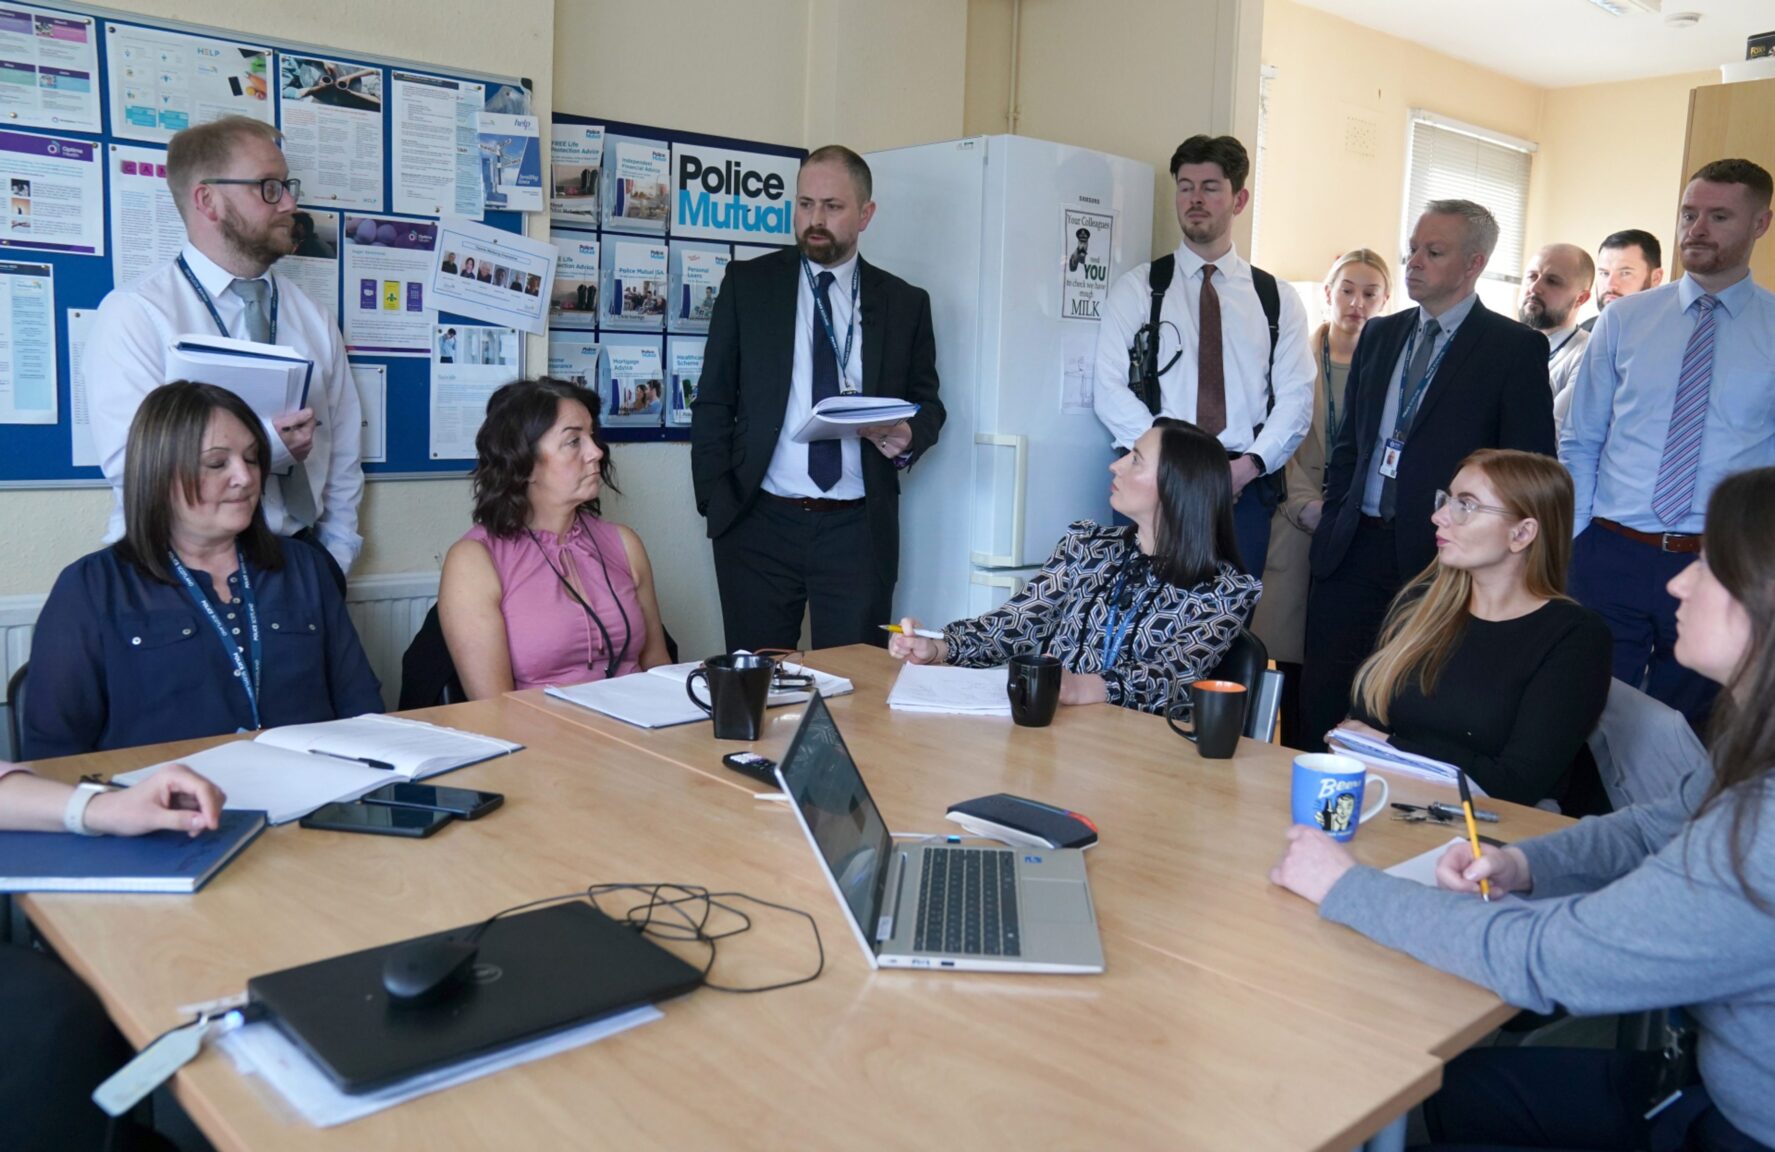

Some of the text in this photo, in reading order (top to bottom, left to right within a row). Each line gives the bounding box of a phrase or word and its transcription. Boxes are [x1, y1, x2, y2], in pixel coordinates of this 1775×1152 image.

[197, 47, 221, 57] HELP
[514, 118, 531, 130] help
[680, 155, 784, 200] Police
[1079, 195, 1100, 205] SAMSUNG
[679, 189, 791, 234] Mutual
[1066, 213, 1110, 231] Your Colleagues
[1084, 264, 1107, 281] YOU
[1071, 298, 1100, 317] MILK
